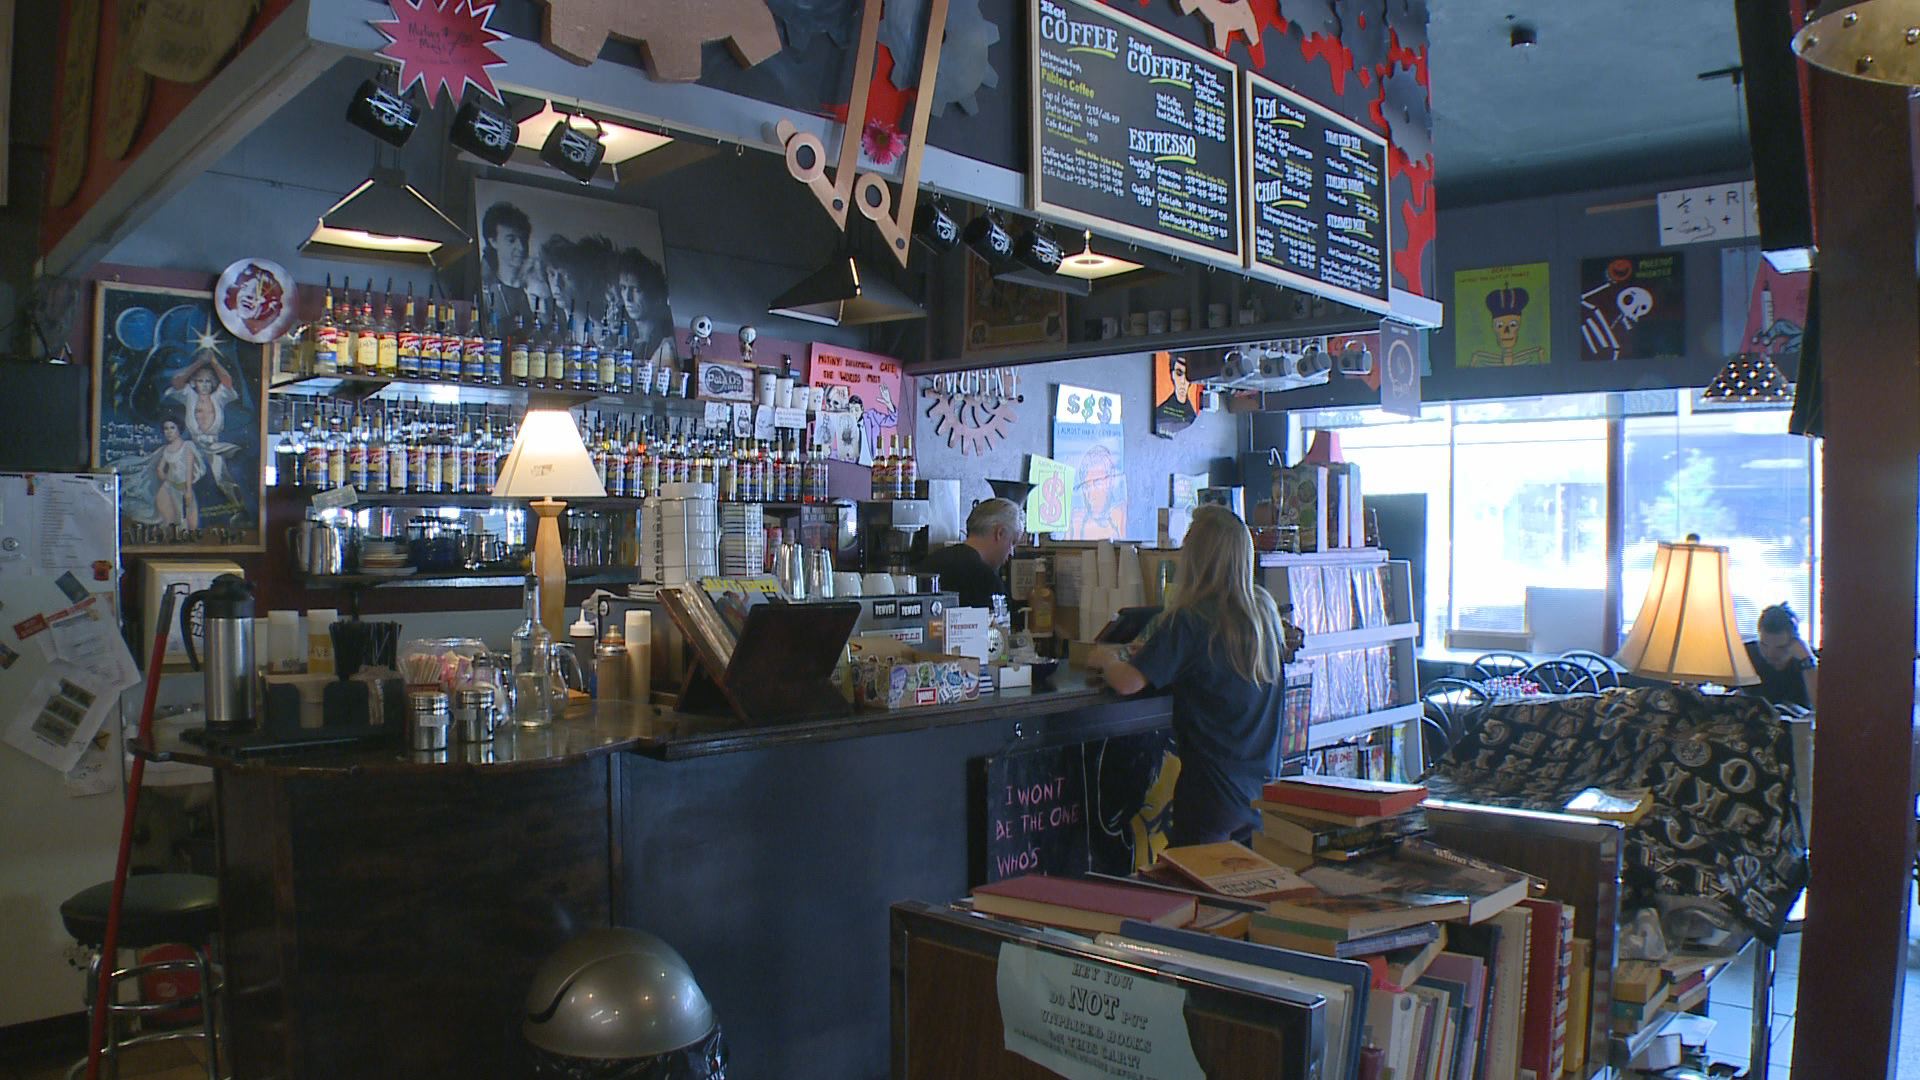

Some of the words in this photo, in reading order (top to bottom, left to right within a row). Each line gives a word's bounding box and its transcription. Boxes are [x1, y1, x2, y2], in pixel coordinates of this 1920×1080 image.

[1041, 0, 1066, 20] Hot
[1041, 15, 1119, 53] COFFEE
[1128, 36, 1152, 56] Iced
[1127, 50, 1192, 82] COFFEE
[1069, 80, 1095, 98] Coffee
[1255, 97, 1277, 119] TEA
[1128, 128, 1196, 158] ESPRESSO
[1255, 181, 1281, 203] CHAI
[818, 355, 840, 366] MUTINY
[823, 370, 833, 379] THE
[875, 604, 895, 616] DENVER
[901, 604, 920, 616] DENVER
[1006, 786, 1012, 805] I
[996, 819, 1013, 841] BE
[1021, 811, 1044, 833] THE
[1050, 804, 1079, 826] ONE
[997, 841, 1040, 877] WHO'S
[1071, 962, 1101, 981] HEY
[1069, 984, 1120, 1021] NOT
[1121, 1011, 1149, 1030] PUT
[1041, 1009, 1104, 1040] UNPRICED
[1106, 1030, 1152, 1054] BOOKS
[1067, 1036, 1098, 1056] THIS
